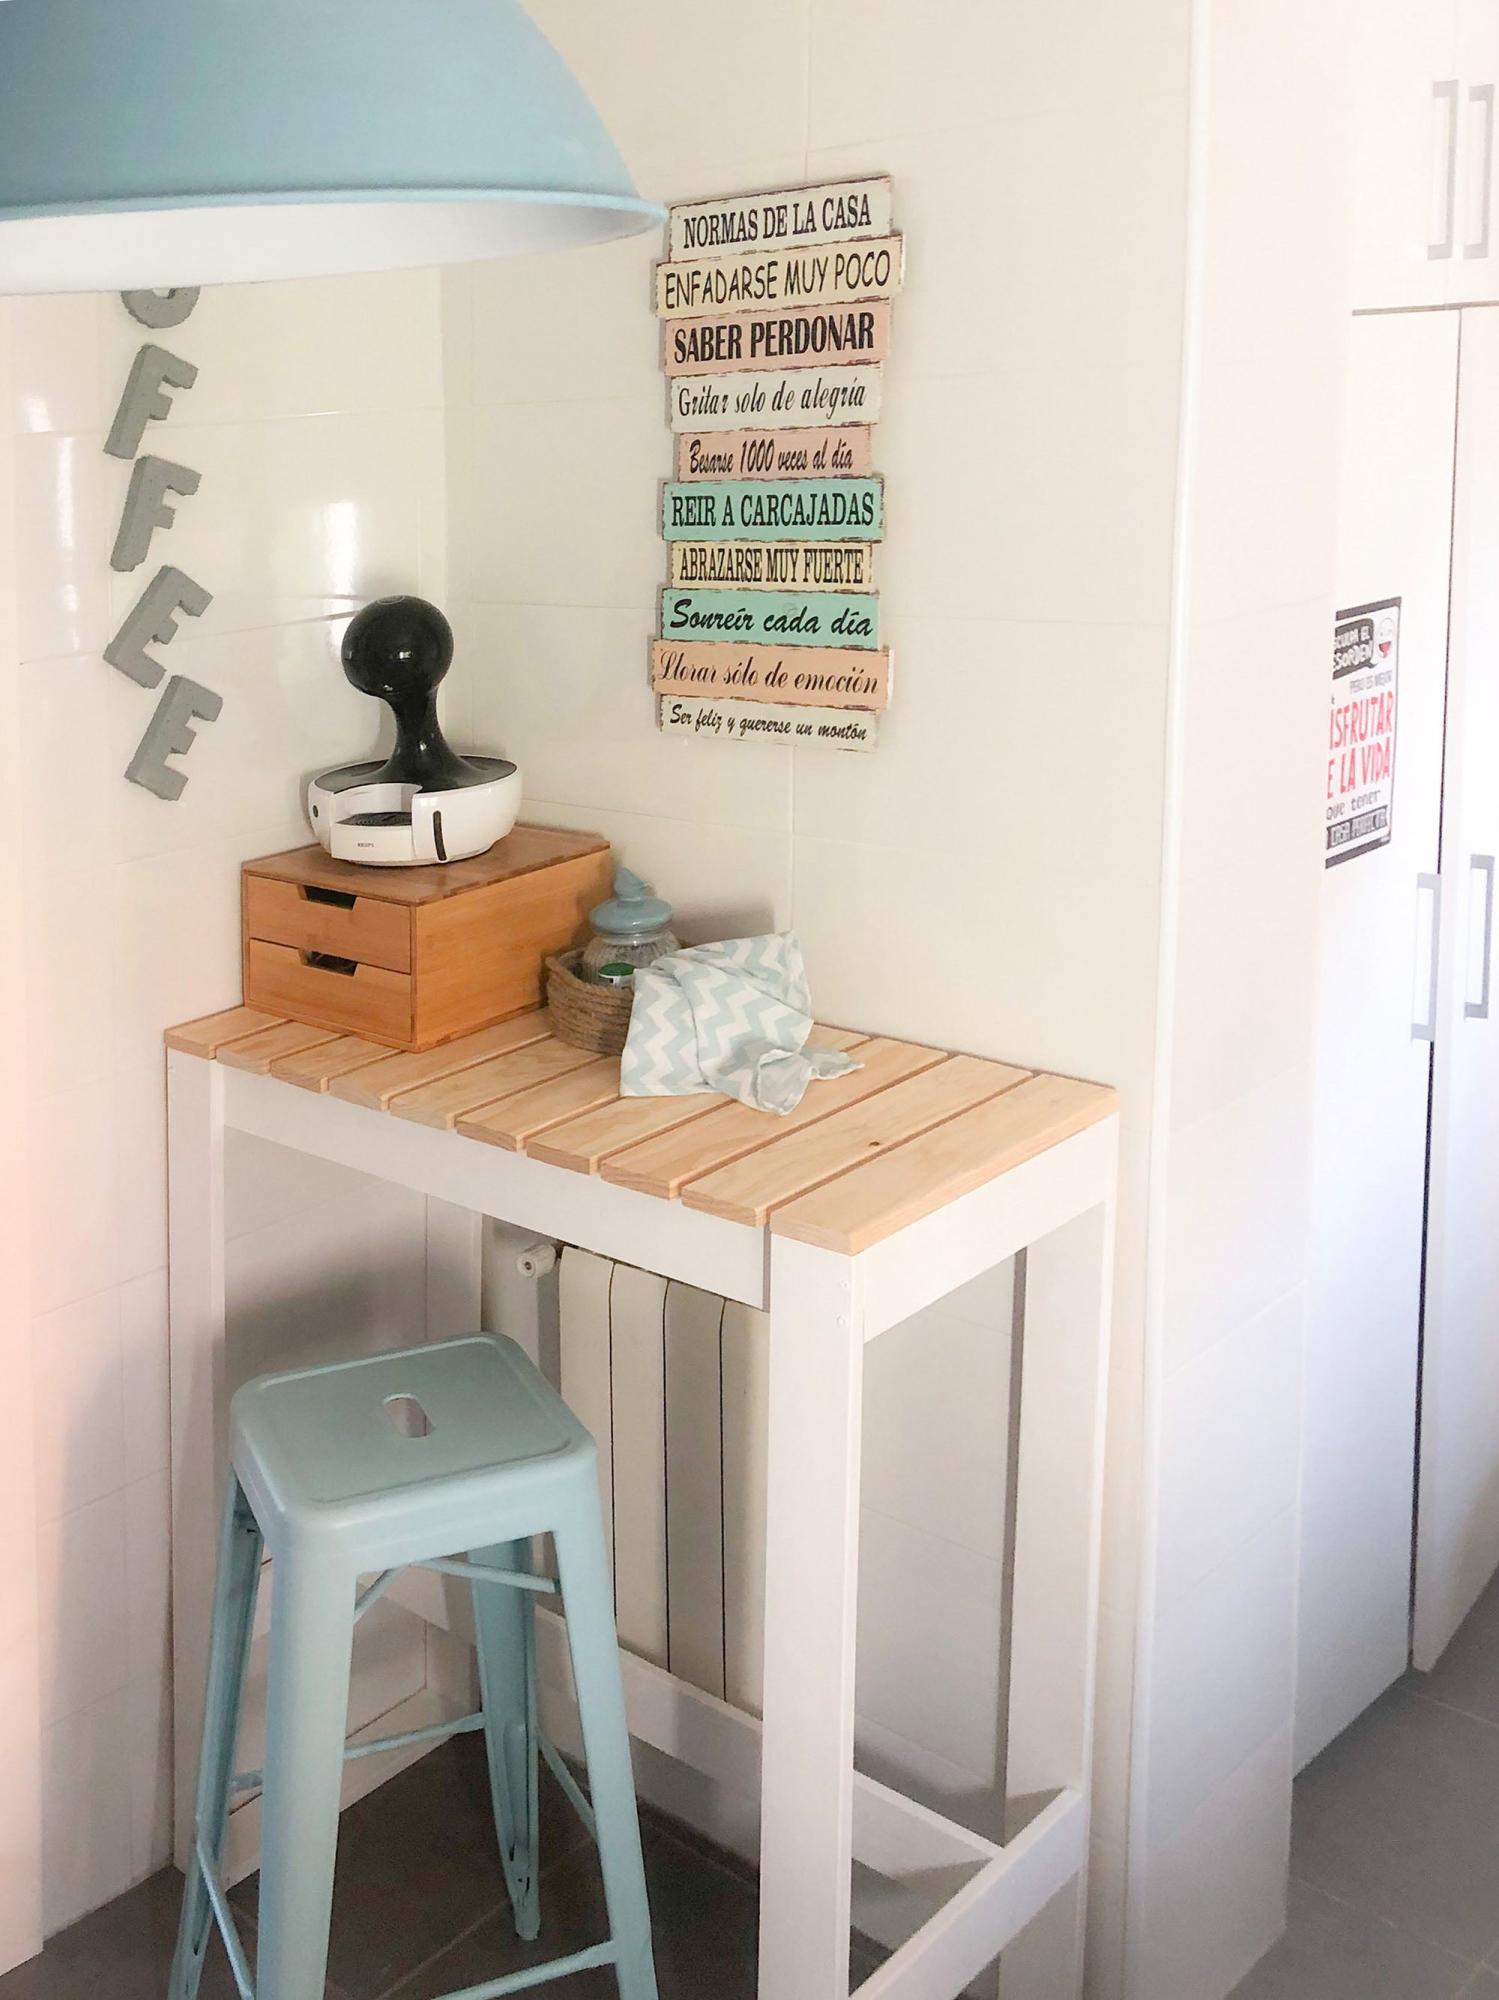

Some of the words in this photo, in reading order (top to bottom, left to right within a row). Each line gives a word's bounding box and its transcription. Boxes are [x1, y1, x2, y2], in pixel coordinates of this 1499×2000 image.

[683, 209, 758, 248] NORMAS
[763, 205, 787, 238] DE
[792, 201, 816, 234] LA
[822, 193, 871, 230] CASA
[666, 261, 778, 309] ENFADARSE
[784, 256, 828, 296] MUY
[834, 250, 890, 290] POCO
[675, 324, 742, 363] SABER
[750, 312, 874, 357] PERDONAR
[679, 385, 729, 416] Gritar
[735, 383, 766, 413] solo
[772, 381, 793, 410] de
[801, 377, 865, 419] alegría
[690, 439, 734, 473] Besarse
[740, 439, 774, 472] 1000
[778, 449, 808, 470] veces
[812, 438, 828, 470] al
[832, 439, 853, 469] día
[672, 495, 716, 526] REIR
[722, 495, 735, 526] A
[741, 492, 874, 526] CARCAJADAS
[680, 548, 762, 582] ABRAZARSE
[766, 548, 799, 583] MUY
[803, 549, 864, 584] FUERTE
[670, 599, 754, 630] Sonreír
[763, 606, 820, 634] cada
[831, 608, 873, 636] día
[658, 650, 718, 680] Llorar
[723, 656, 758, 686] sólo
[765, 661, 788, 688] de
[794, 666, 878, 694] emoción
[670, 704, 691, 724] Ser
[695, 708, 721, 734] feliz
[727, 717, 734, 730] y
[740, 715, 791, 735] quererse
[796, 721, 813, 735] un
[818, 723, 867, 740] montón
[1329, 691, 1393, 750] ISFRUTAR
[1327, 758, 1335, 799] E
[1340, 747, 1356, 794] LA
[1361, 736, 1391, 785] VIDA
